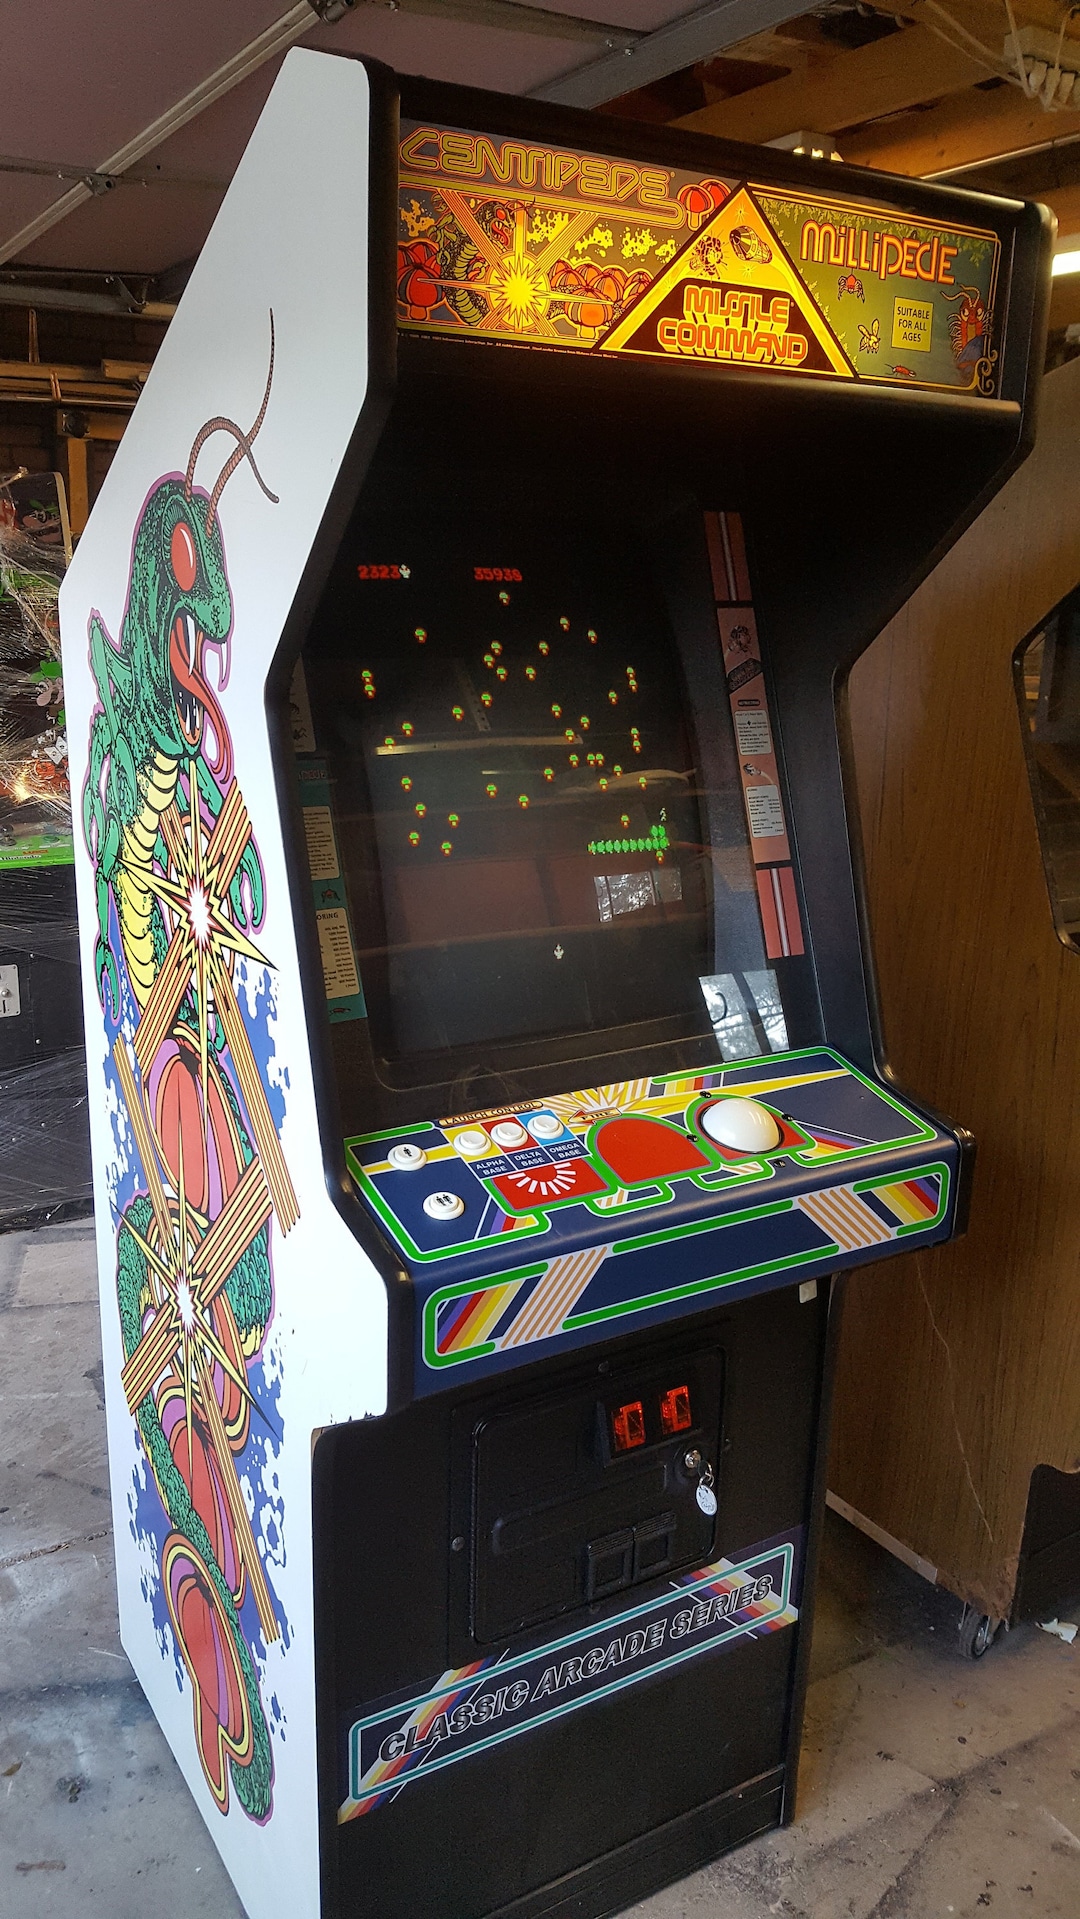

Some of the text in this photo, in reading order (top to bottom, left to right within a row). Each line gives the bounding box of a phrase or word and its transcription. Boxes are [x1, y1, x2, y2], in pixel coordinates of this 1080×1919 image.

[400, 127, 671, 201] CENTIPEDE
[683, 285, 790, 327] MISSILE
[897, 307, 929, 319] SUITABLE
[898, 318, 927, 331] FOR ALL
[657, 317, 808, 364] COMMAND
[902, 331, 921, 342] AGES
[316, 912, 339, 920] ORING
[444, 1101, 538, 1125] LAUNCH CONTROL
[581, 1110, 613, 1121] FIRE
[549, 1142, 580, 1153] OMEGA
[514, 1151, 542, 1161] DELTA
[558, 1149, 582, 1159] BASE
[476, 1159, 506, 1170] ALPHA
[521, 1156, 545, 1167] BASE
[482, 1165, 508, 1176] BASE
[379, 1574, 774, 1763] CLASSIC ARCADE SERIES
